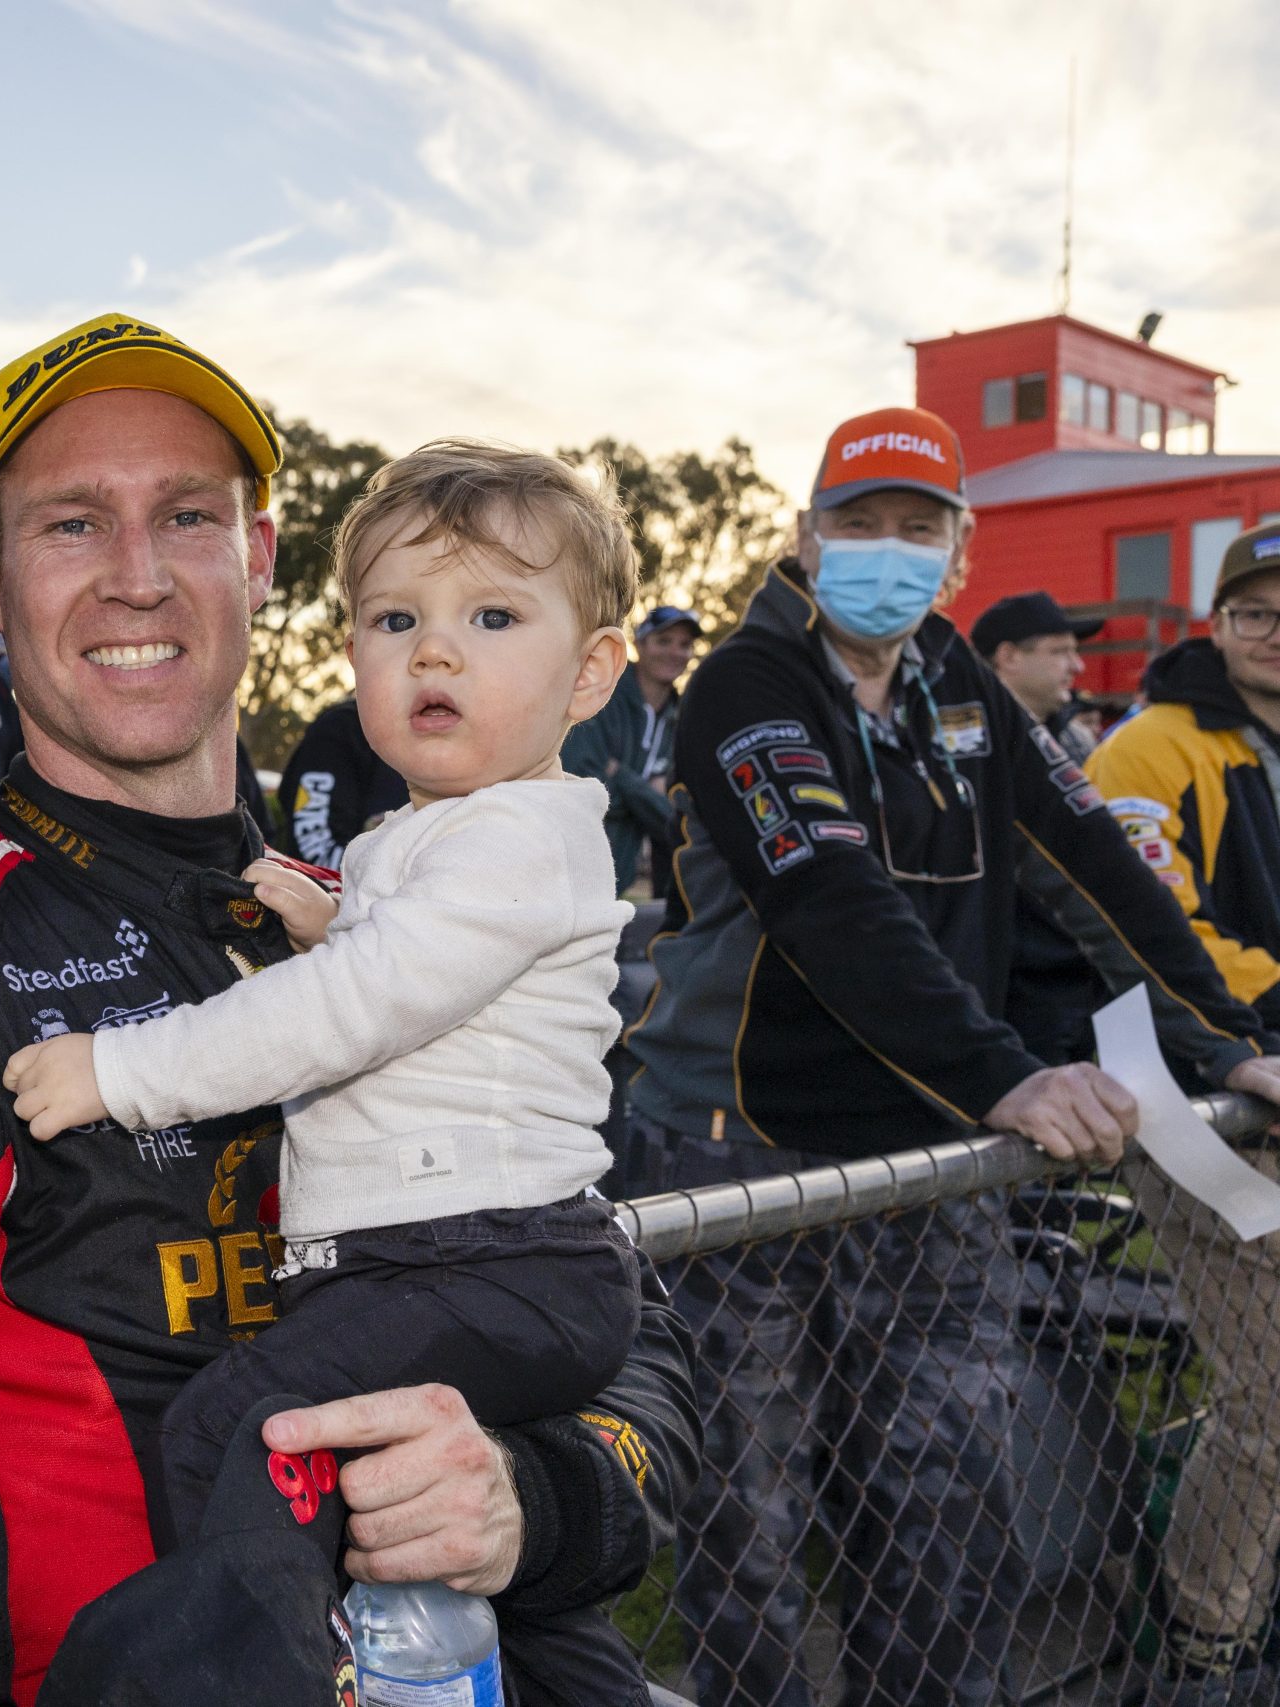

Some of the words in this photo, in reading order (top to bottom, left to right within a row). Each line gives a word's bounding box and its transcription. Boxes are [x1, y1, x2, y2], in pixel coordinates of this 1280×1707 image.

[841, 432, 947, 464] OFFICIAL
[2, 952, 138, 992] Steadfast
[135, 1126, 197, 1162] HIRE
